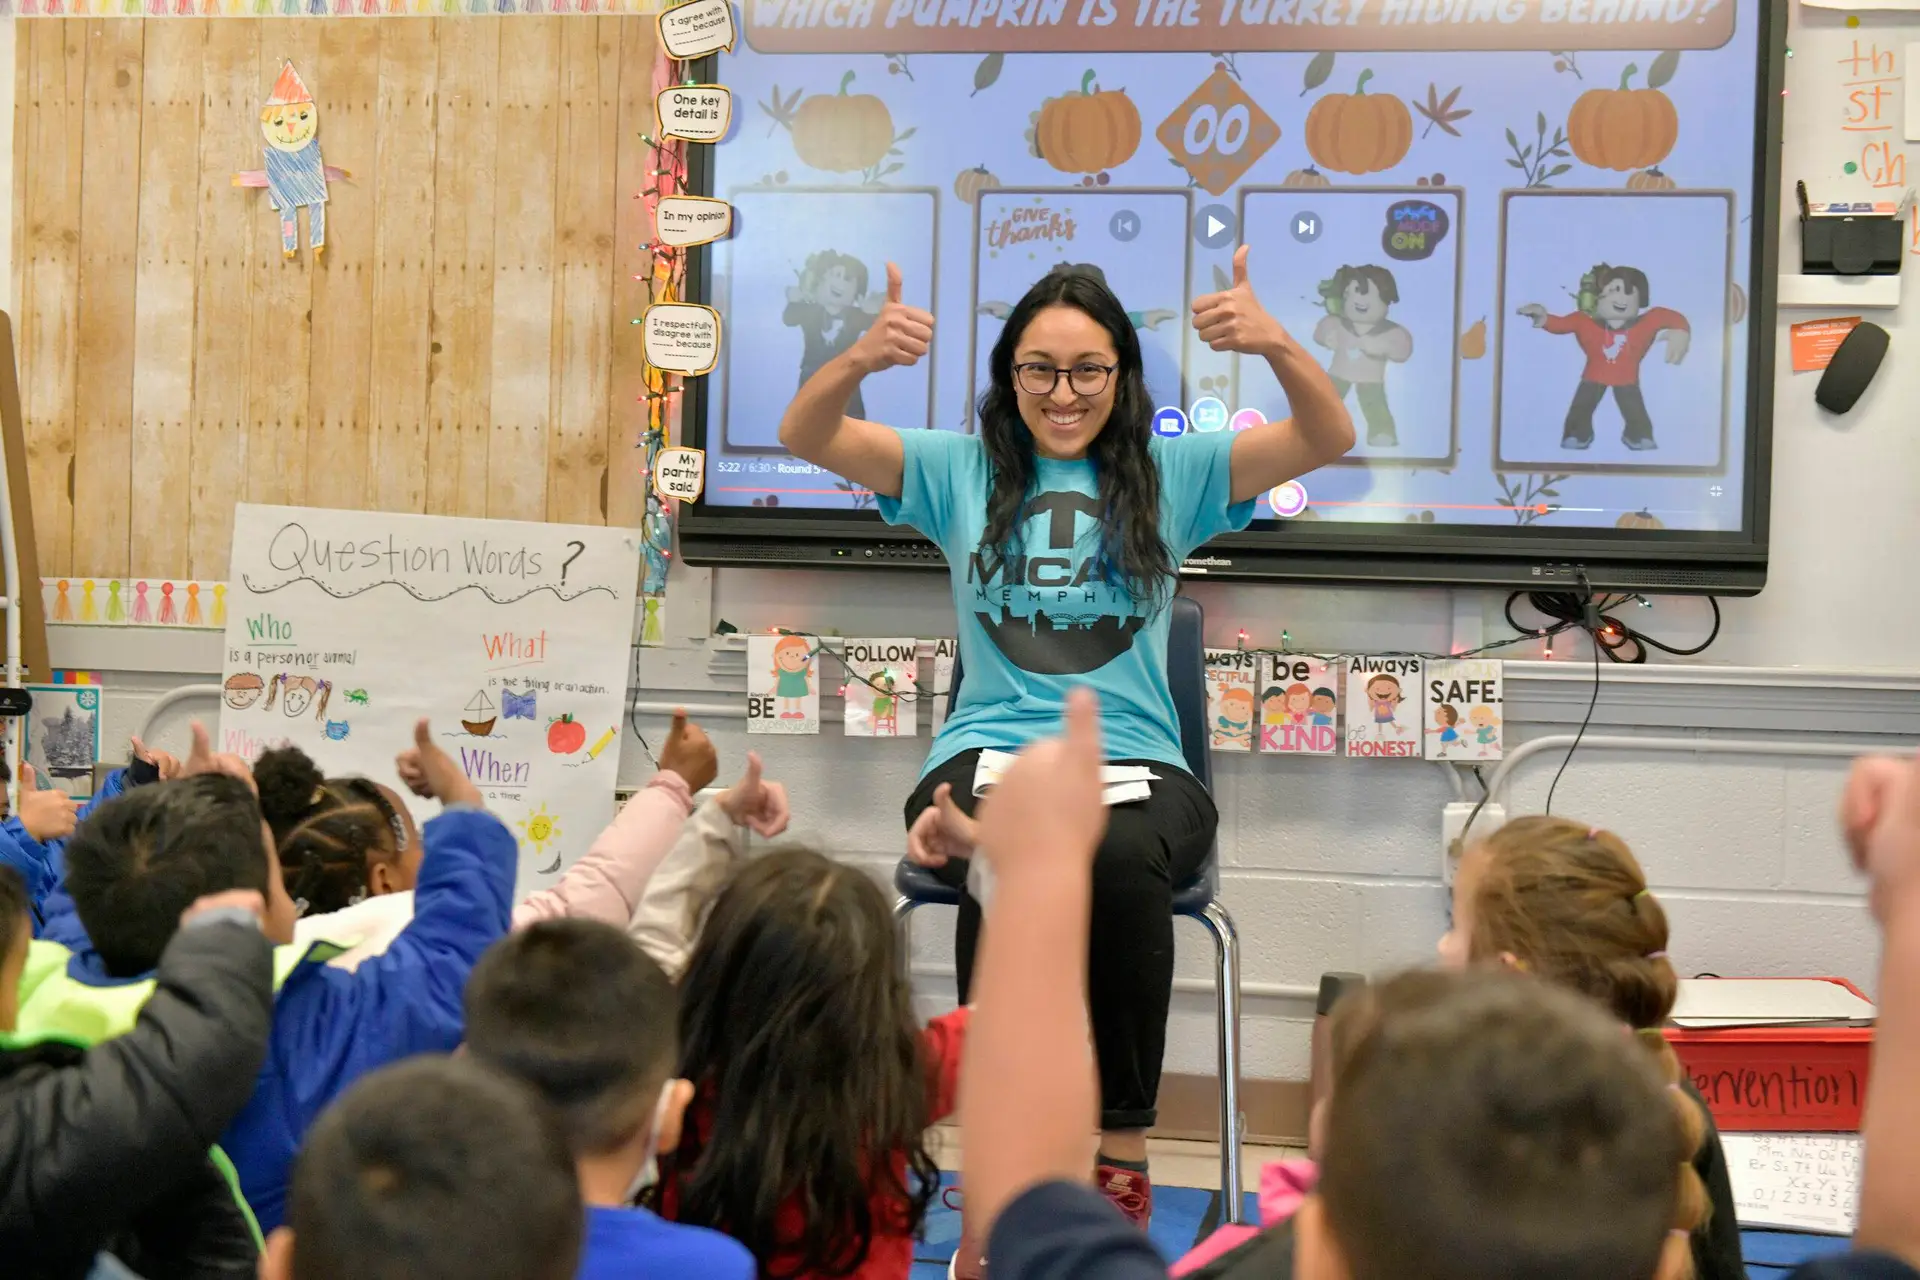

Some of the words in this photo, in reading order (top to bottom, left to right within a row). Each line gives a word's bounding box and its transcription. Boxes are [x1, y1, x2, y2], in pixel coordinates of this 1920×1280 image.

[670, 18, 676, 26] I
[678, 13, 704, 27] agree
[706, 6, 723, 20] with
[752, 0, 876, 29] WHICH
[1077, 0, 1119, 27] IS
[1133, 0, 1202, 27] THE
[1380, 0, 1528, 25] HIDING
[1540, 0, 1728, 25] BEHIND?
[693, 16, 726, 32] because
[674, 94, 697, 106] One
[701, 94, 721, 108] key
[674, 107, 708, 120] detail
[710, 108, 719, 120] is
[663, 210, 675, 221] In
[677, 212, 693, 224] my
[696, 211, 726, 222] opinion
[1012, 207, 1051, 223] GIVE
[984, 212, 1077, 250] thanks
[1391, 232, 1425, 250] ON
[653, 318, 658, 327] I
[660, 319, 713, 331] respectfully
[653, 328, 692, 339] disagree
[694, 329, 712, 340] with
[676, 339, 712, 349] because
[678, 453, 697, 466] My
[717, 462, 741, 473] 5:22
[748, 462, 772, 473] 6:30
[778, 463, 812, 475] Round
[268, 522, 450, 577] Question
[462, 539, 543, 580] Words
[560, 539, 586, 587] ?
[1184, 555, 1232, 567] romethean
[976, 589, 1118, 604] MEMPHI
[246, 612, 293, 641] Who
[482, 630, 550, 661] What
[845, 645, 917, 663] FOLLOW
[229, 647, 240, 663] is
[243, 650, 252, 664] a
[1272, 656, 1310, 681] be
[1350, 656, 1420, 677] Always
[1430, 679, 1504, 704] SAFE.
[748, 697, 775, 719] BE
[1260, 724, 1337, 752] KIND
[1348, 740, 1421, 757] HONEST.
[460, 746, 531, 783] When
[488, 791, 497, 799] a
[1686, 1064, 1859, 1115] ervention
